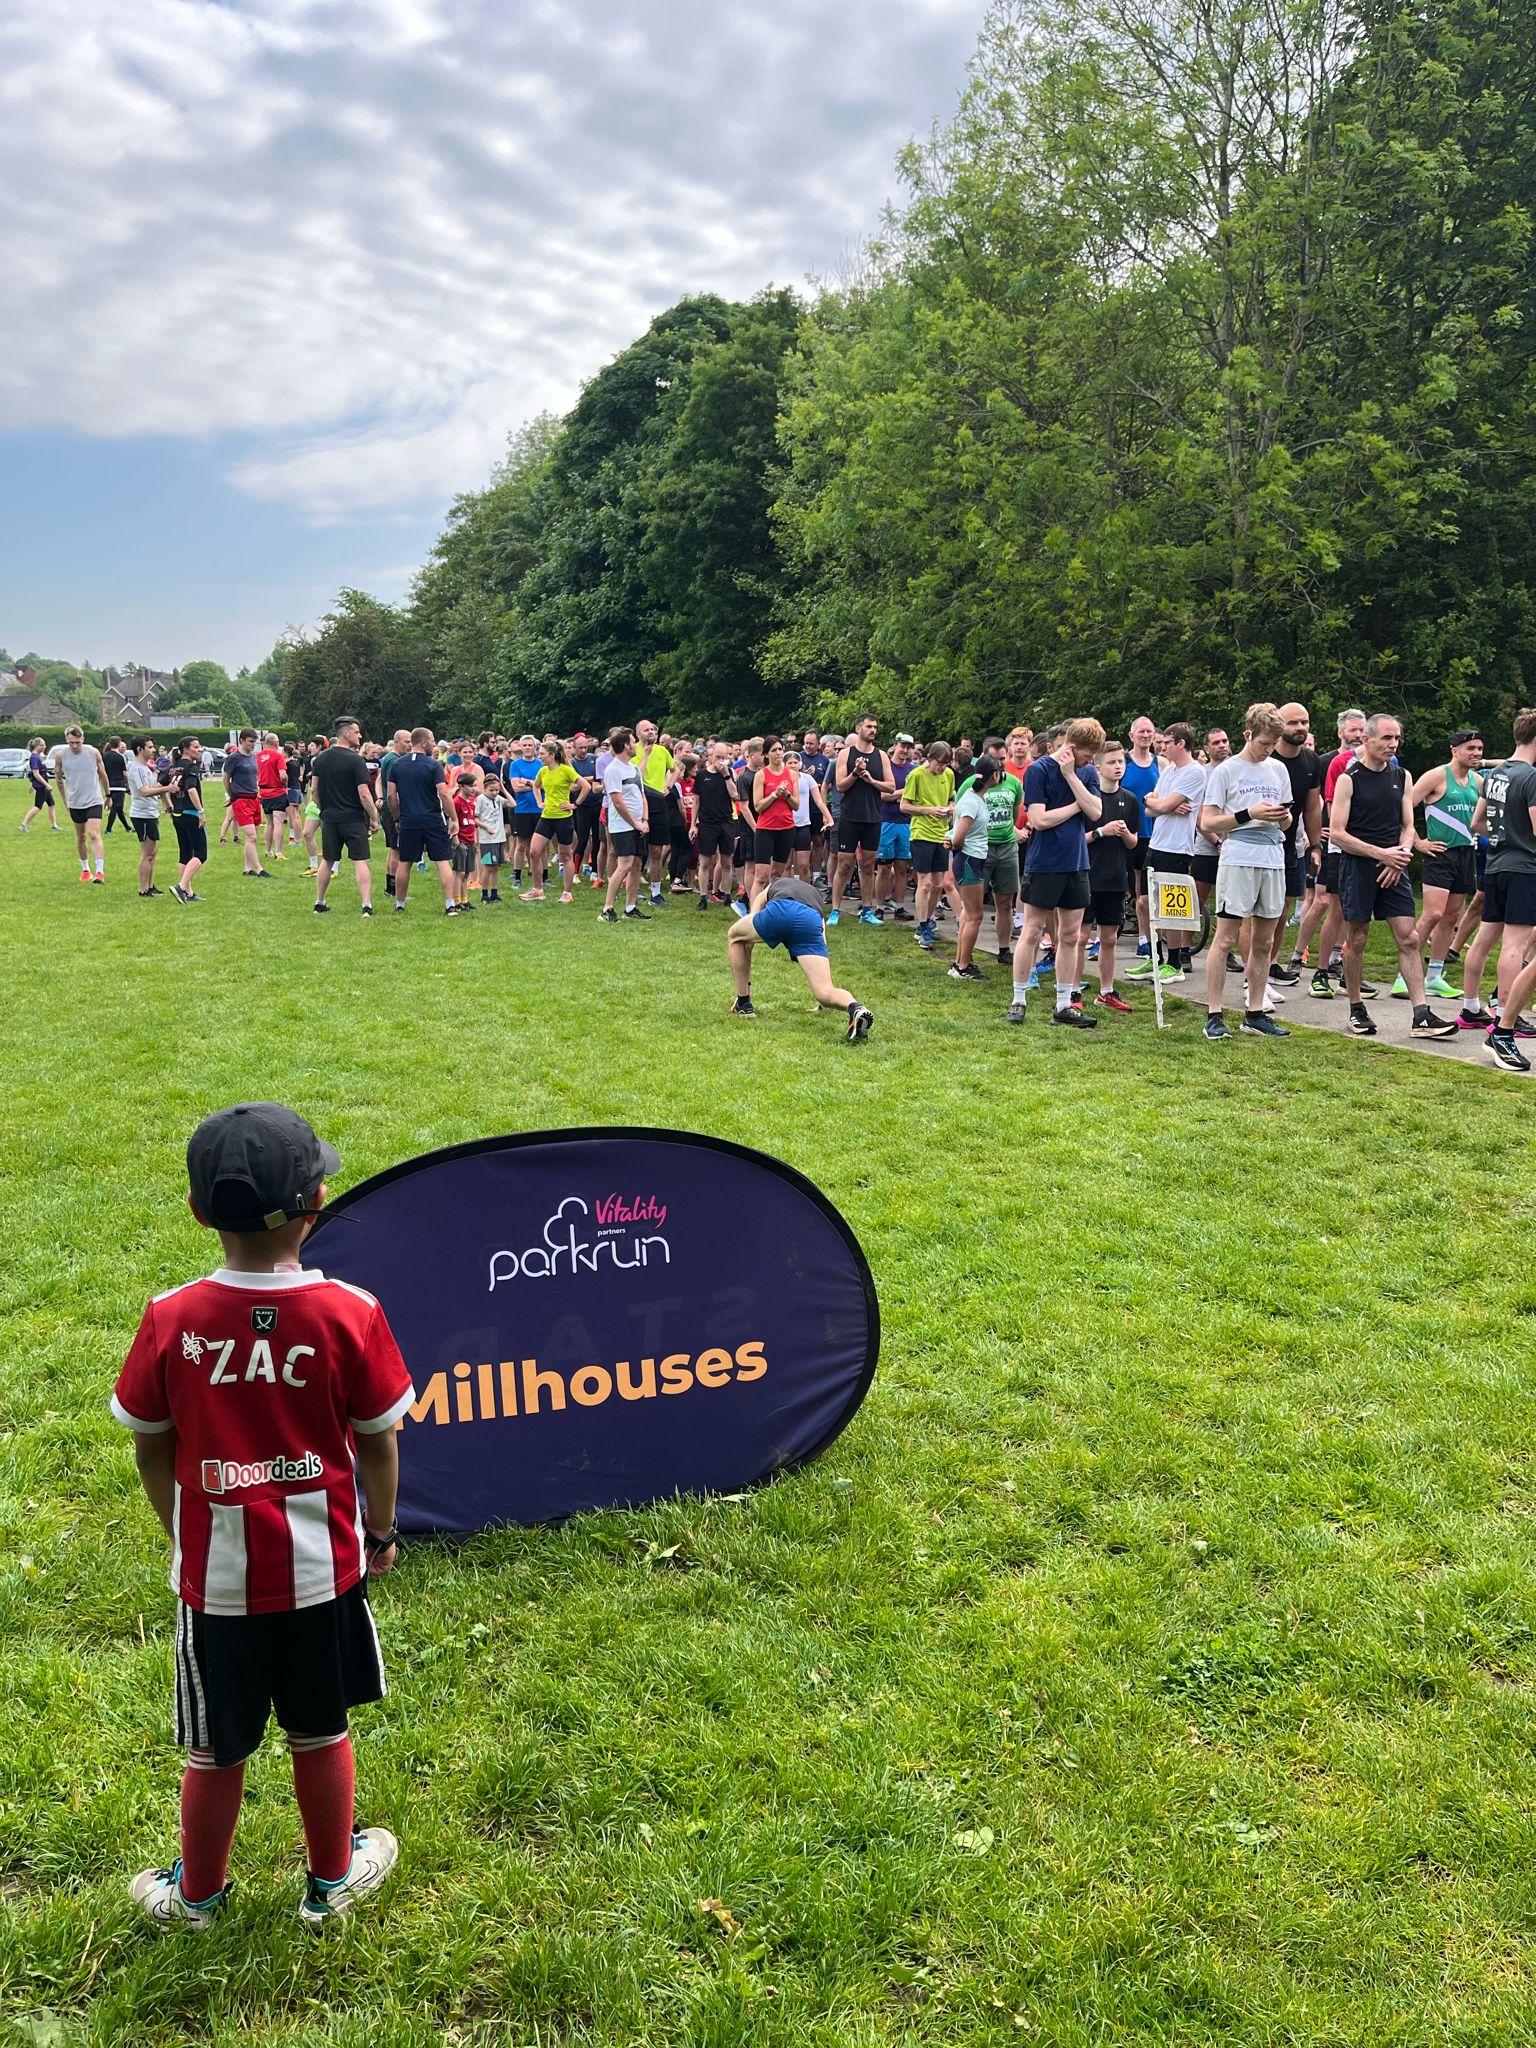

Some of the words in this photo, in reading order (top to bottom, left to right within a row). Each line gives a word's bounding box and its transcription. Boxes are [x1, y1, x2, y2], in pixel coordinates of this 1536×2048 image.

[1486, 778, 1510, 799] 10K
[1164, 884, 1174, 892] UP
[1177, 885, 1187, 893] TO
[1166, 892, 1187, 908] 20
[1165, 908, 1187, 917] MINS
[595, 1192, 667, 1229] Vitality
[597, 1228, 626, 1238] partners
[488, 1220, 671, 1292] parkrun
[207, 1339, 316, 1388] ZAC
[395, 1341, 768, 1431] Millhouses
[225, 1453, 322, 1487] Doordeals
